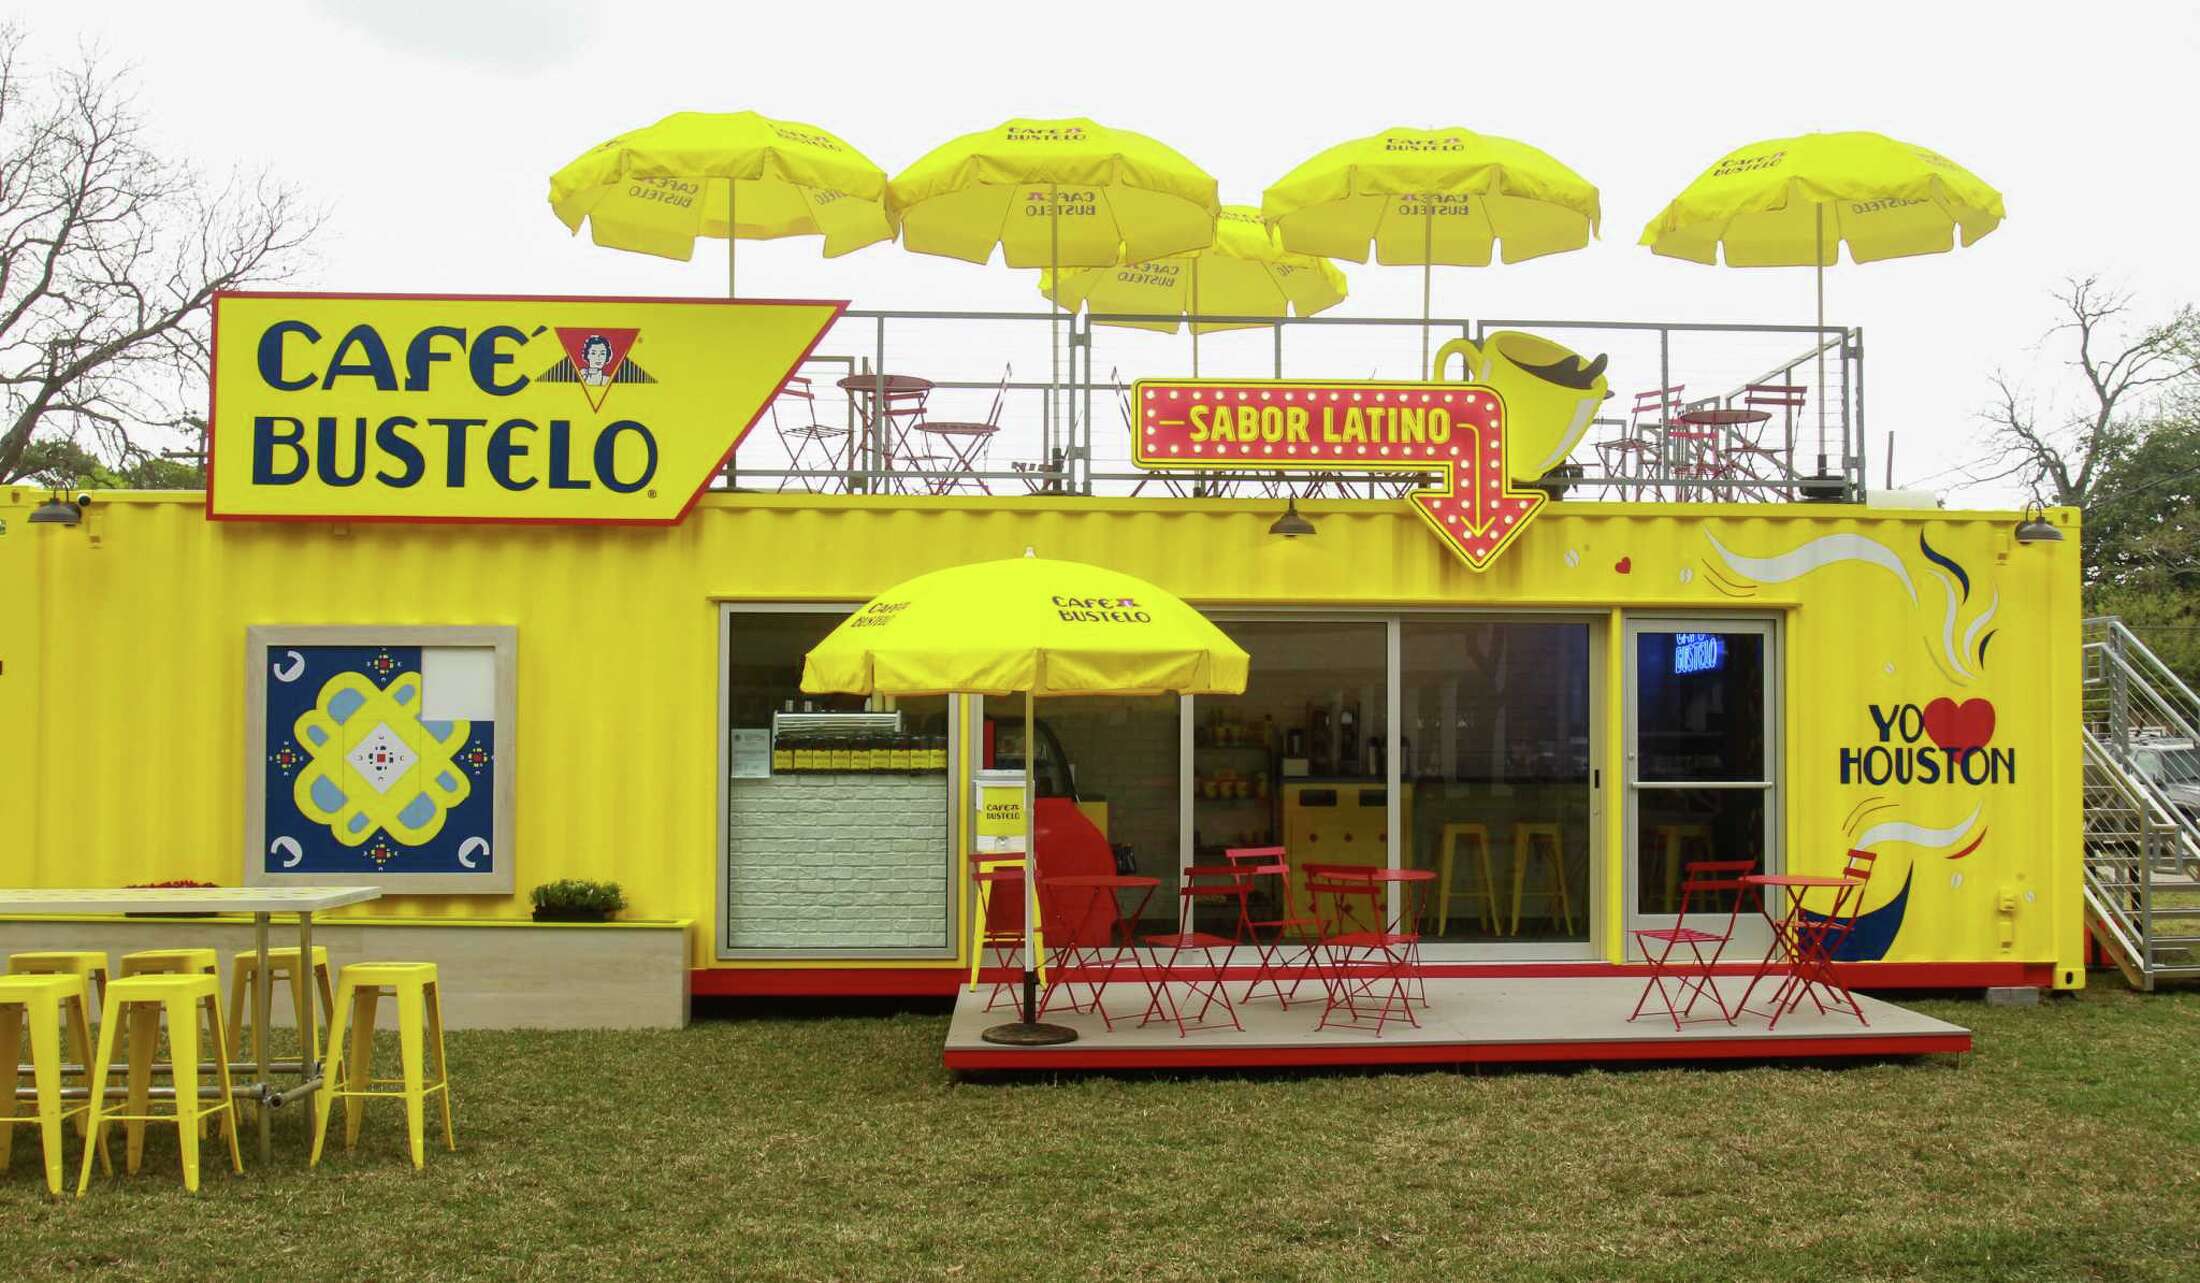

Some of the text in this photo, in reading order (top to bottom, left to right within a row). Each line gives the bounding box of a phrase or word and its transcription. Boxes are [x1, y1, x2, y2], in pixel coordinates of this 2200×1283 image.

[257, 320, 549, 397] CAFÉ
[1189, 404, 1452, 445] SABOR LATINO
[252, 416, 658, 494] BUSTELO
[1058, 610, 1152, 624] BUSTELO
[1868, 703, 1924, 744] YO
[1839, 745, 2016, 786] HOUSTON
